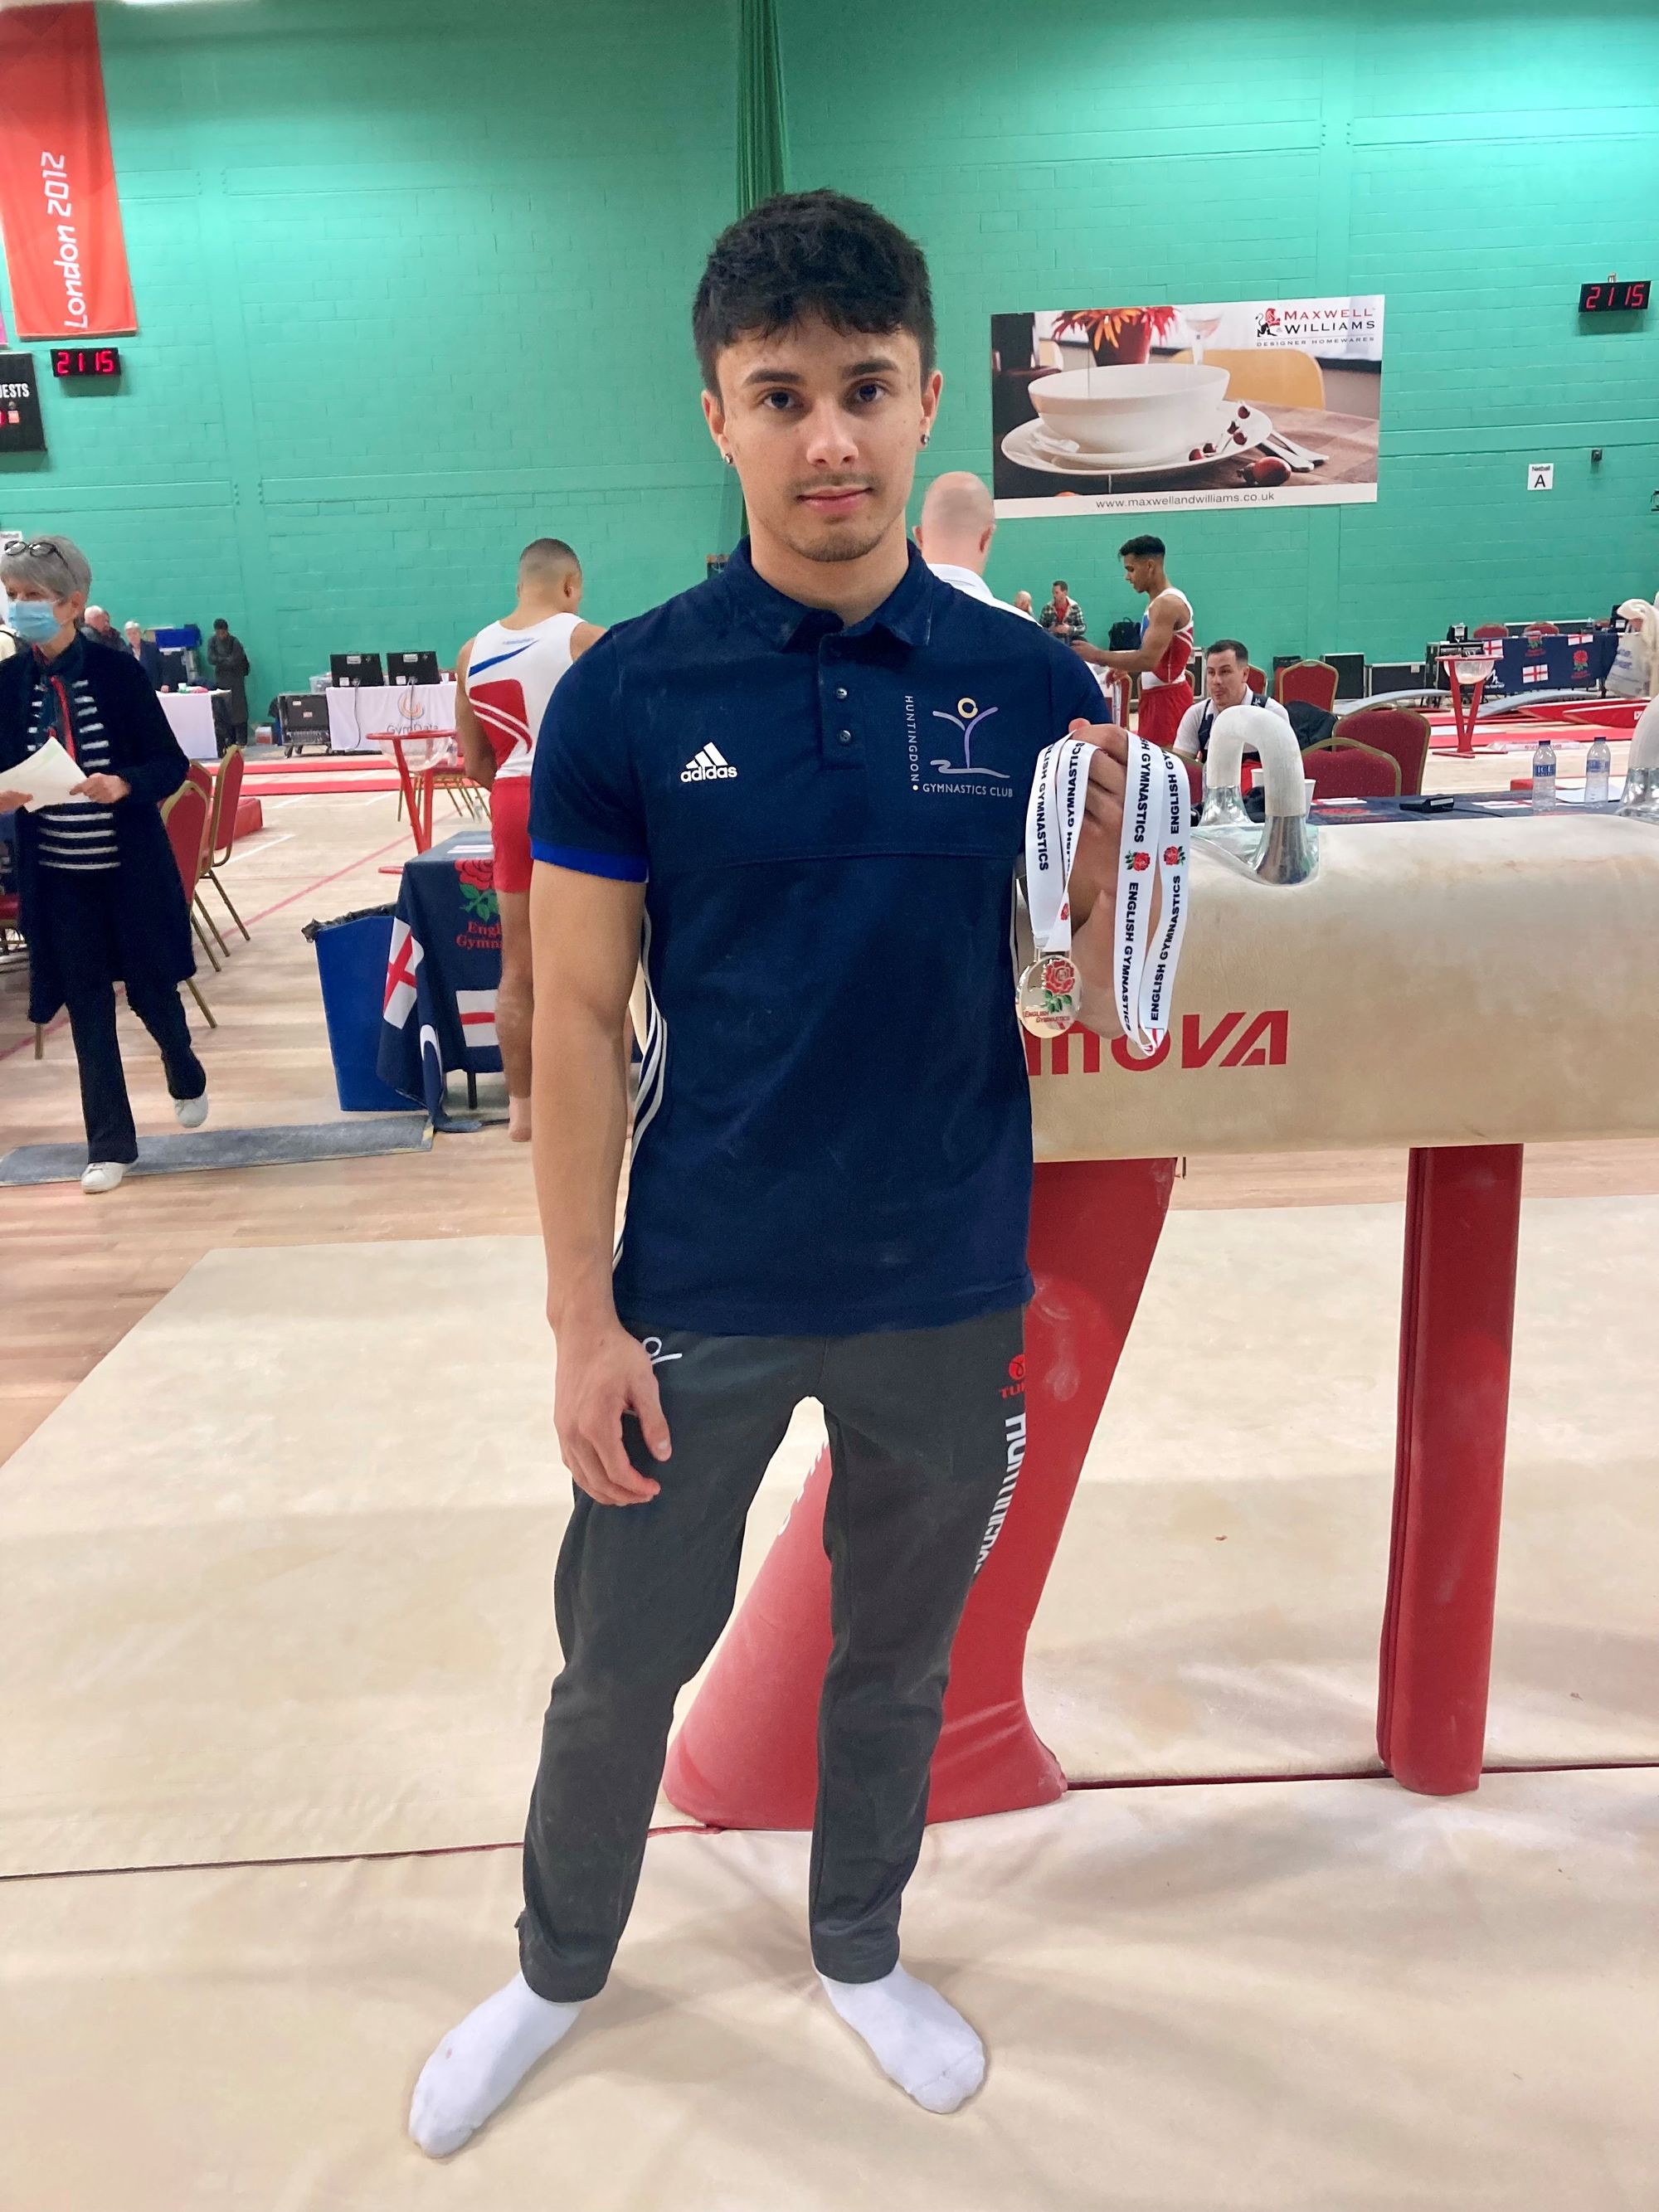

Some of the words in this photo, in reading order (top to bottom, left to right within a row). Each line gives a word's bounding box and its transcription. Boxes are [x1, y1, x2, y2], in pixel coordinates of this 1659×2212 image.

[41, 152, 72, 217] 2012
[53, 225, 88, 328] London
[1284, 308, 1373, 321] MAXWELL
[1284, 320, 1375, 334] WILLIAMS
[1096, 492, 1275, 508] www.maxwellandwilliams.co.uk
[1535, 474, 1546, 488] A
[904, 695, 920, 782] HUNTINGDON
[680, 766, 737, 783] adidas
[922, 783, 986, 795] GYMNASTICS
[990, 787, 1014, 798] CLUB
[1067, 742, 1085, 828] GYMNASTICS
[1134, 753, 1151, 843] GYMNASTICS
[1168, 774, 1180, 834] ENGLISH
[1036, 783, 1049, 871] GYMNASTICS
[468, 921, 502, 937] Engl
[1125, 882, 1139, 941] ENGLISH
[1151, 964, 1166, 1021] ENGLISH
[1160, 875, 1180, 960] GYMNASTICS
[1121, 946, 1133, 1032] GYMNASTICS
